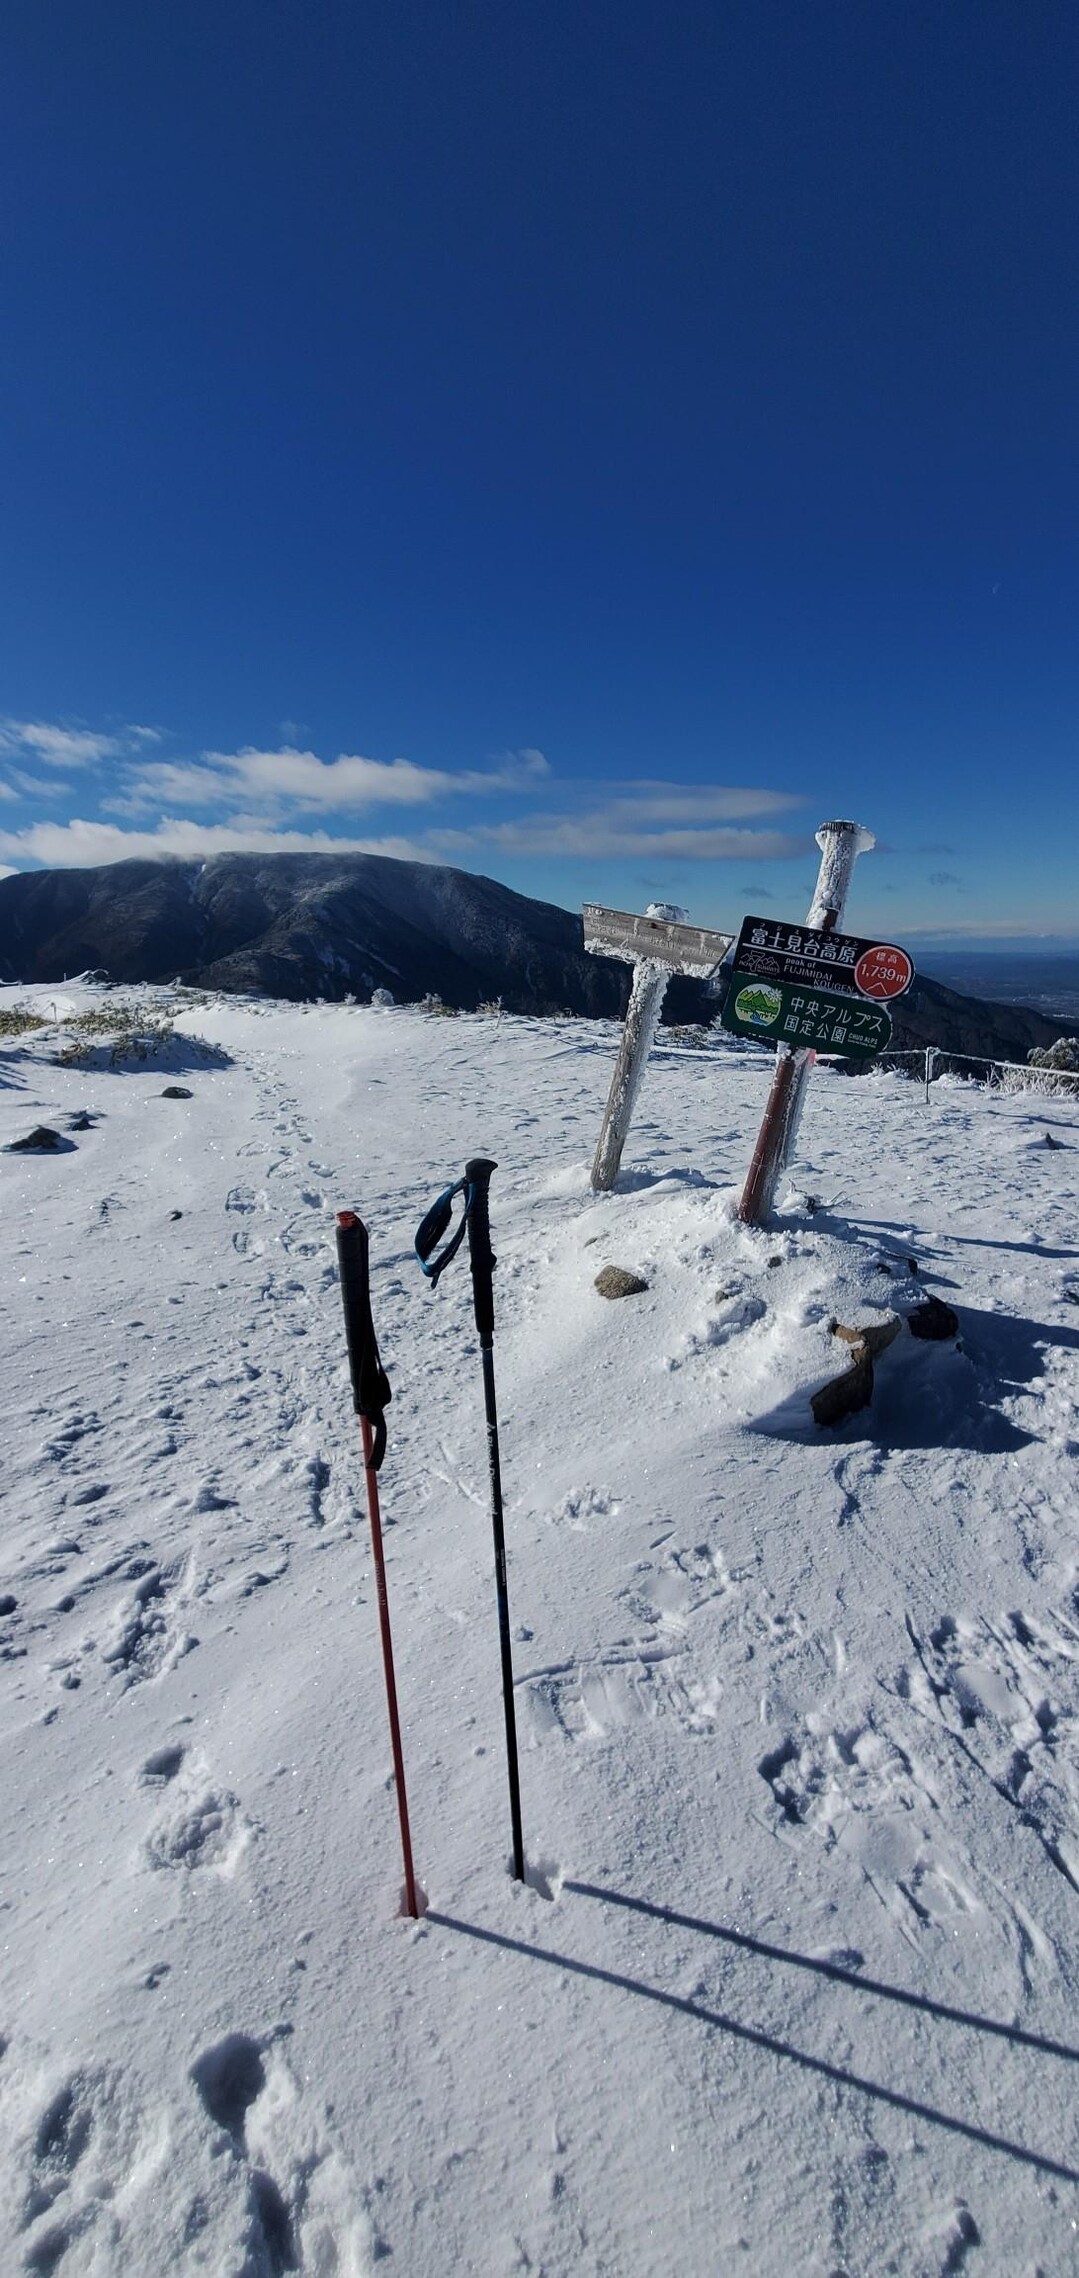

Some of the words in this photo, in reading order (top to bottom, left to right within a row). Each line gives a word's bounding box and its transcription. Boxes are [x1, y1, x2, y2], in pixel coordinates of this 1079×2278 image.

[750, 928, 858, 964] 富士見台高原
[785, 957, 805, 967] peak
[807, 960, 816, 968] of
[876, 951, 899, 964] 標高
[783, 964, 833, 983] FUJIMIDAI
[813, 978, 855, 993] KOUGEN
[790, 996, 883, 1033] 中央アルプス
[783, 1014, 847, 1044] 国定公園
